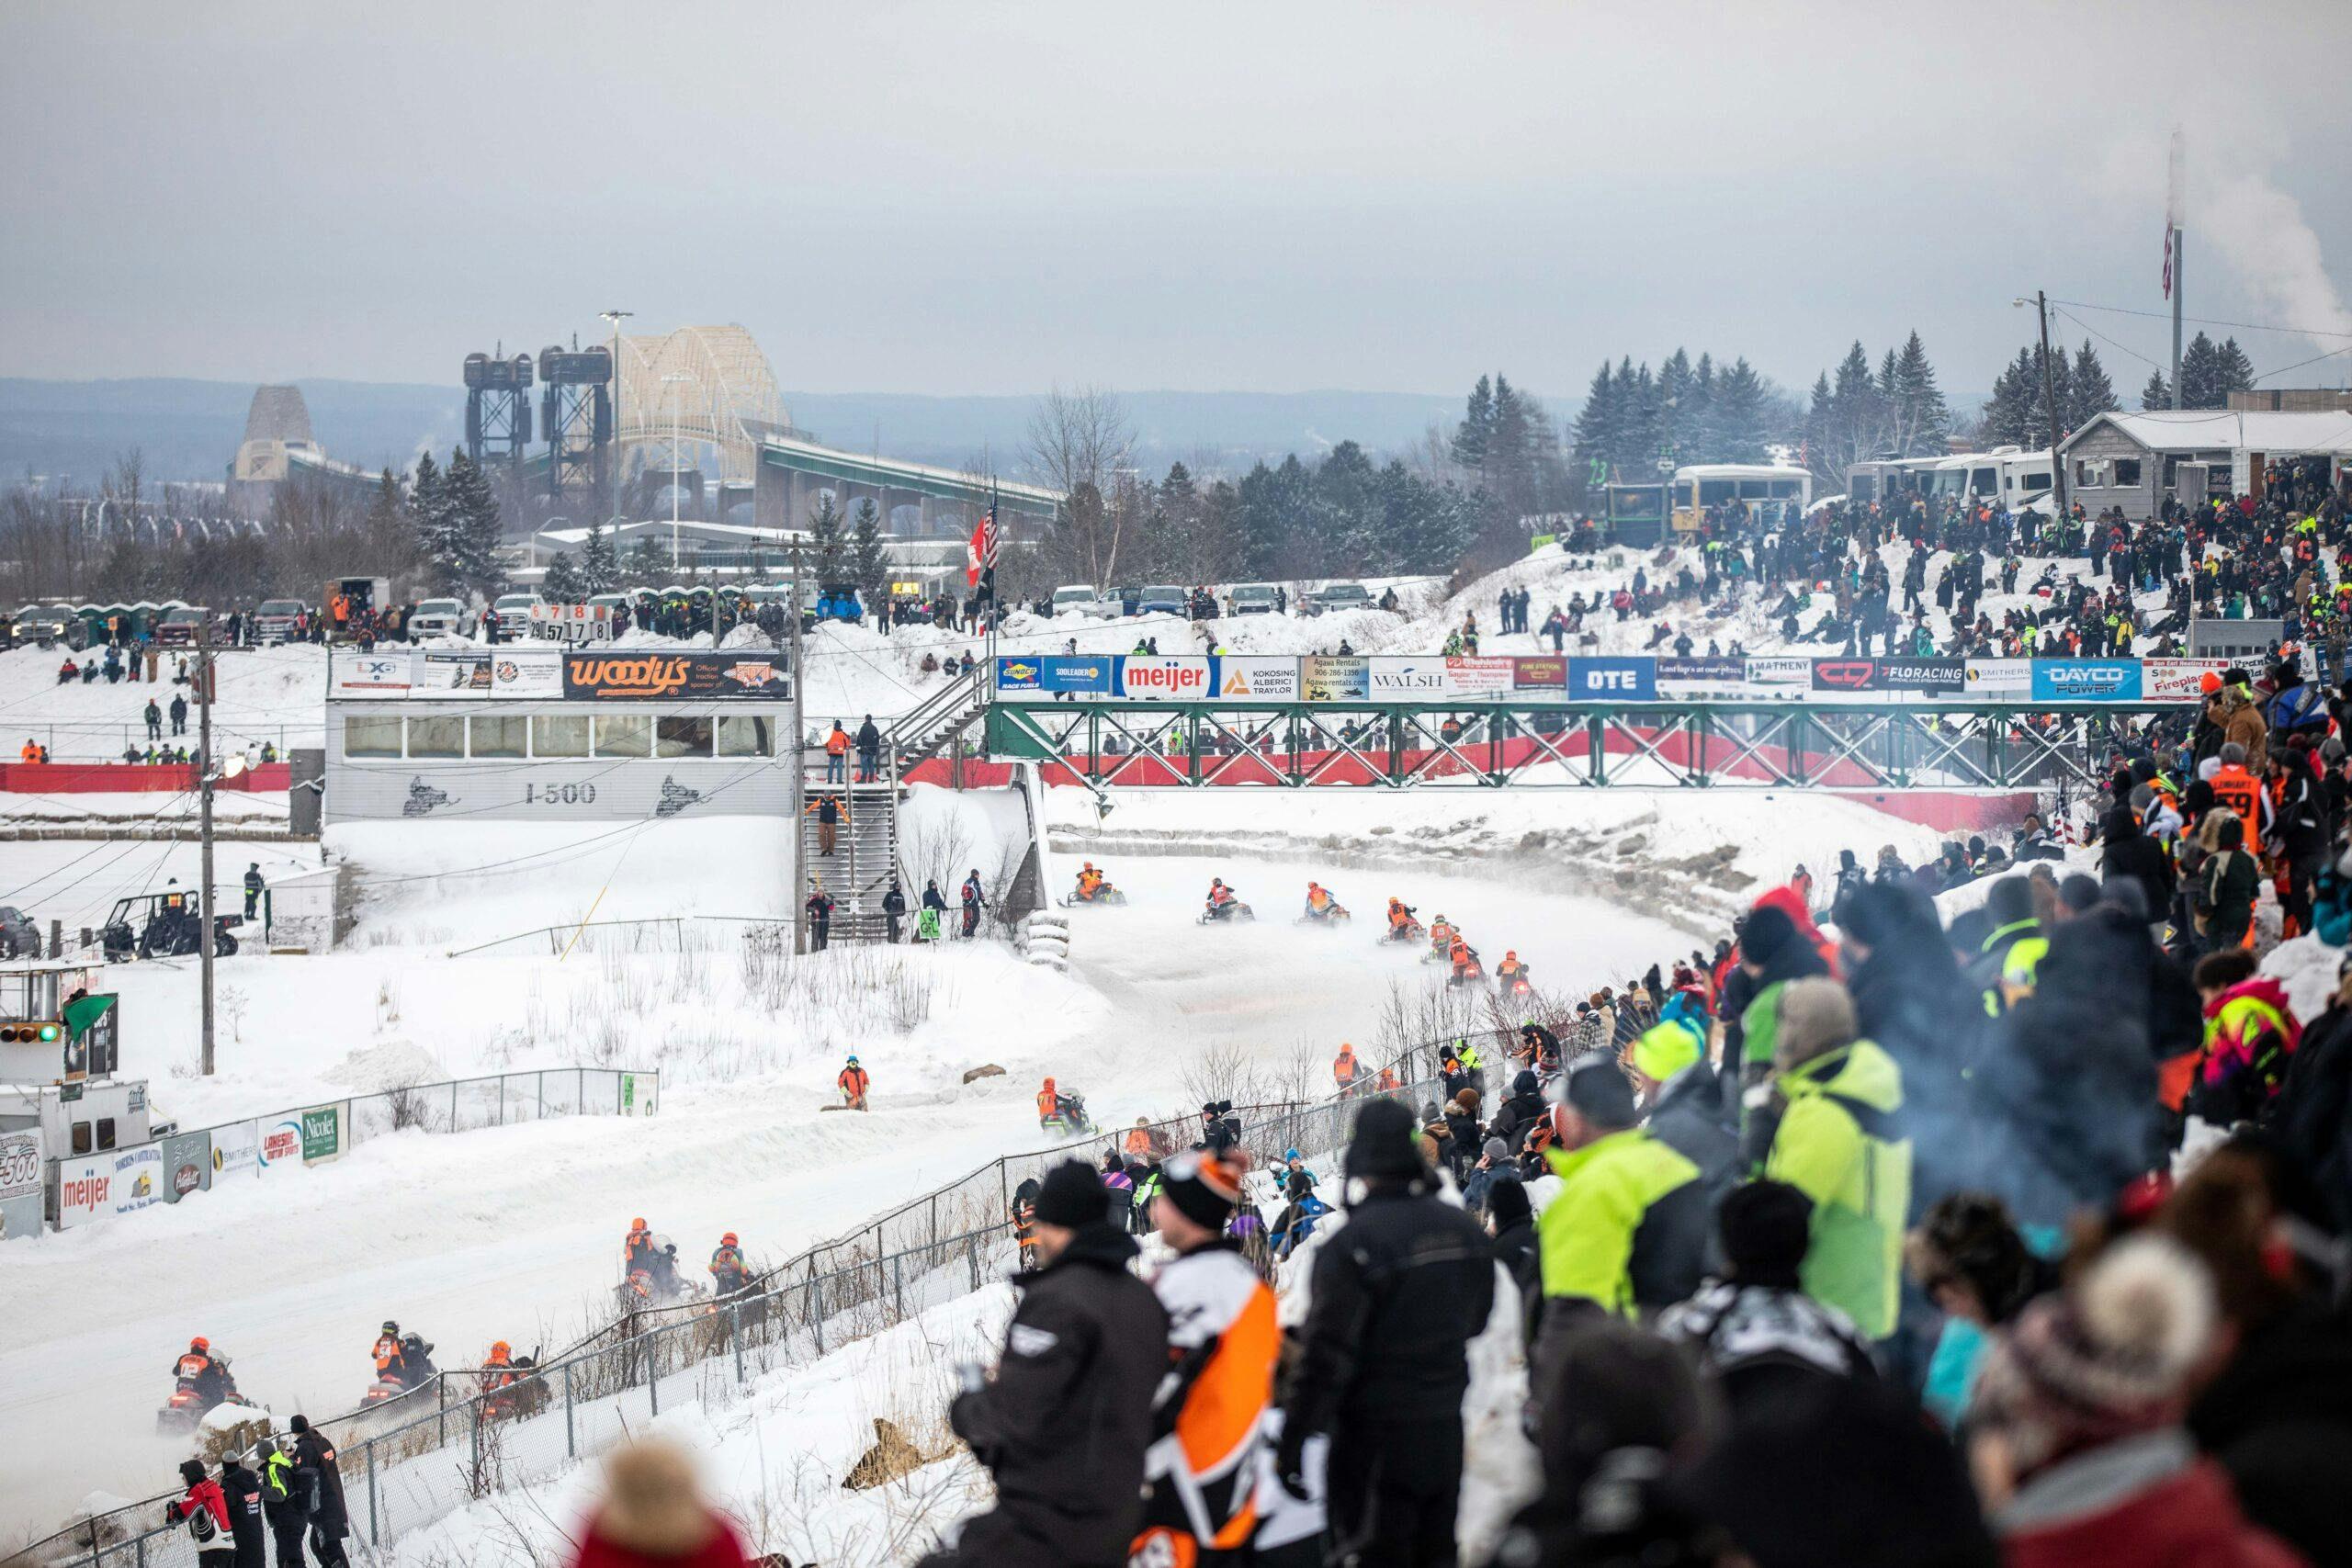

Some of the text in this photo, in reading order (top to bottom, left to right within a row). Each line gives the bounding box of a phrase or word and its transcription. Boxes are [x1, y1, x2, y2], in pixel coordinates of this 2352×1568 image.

[532, 605, 605, 619] 6 7 8 9
[531, 622, 604, 641] 29 57 7 8
[1314, 659, 1361, 668] Agawa Rentals
[1696, 665, 1704, 673] at
[1756, 661, 1808, 670] MATHENY
[1004, 668, 1036, 676] SUNOCO
[1056, 668, 1090, 677] SOOLEADER
[1128, 661, 1204, 692] meijer
[1252, 670, 1296, 678] KOKOSING
[1889, 667, 1962, 680] FLORACING
[2049, 667, 2124, 682] DAYCO
[1306, 678, 1368, 686] Agawa-rentals.com
[1374, 675, 1442, 687] WALSH
[1587, 670, 1637, 691] DTE
[2056, 683, 2117, 694] POWER
[526, 783, 596, 806] I-500
[305, 1114, 334, 1140] Nicolet
[264, 1131, 295, 1151] LAKESIDE
[224, 1145, 257, 1163] SMITHERS
[64, 1169, 110, 1213] meijer
[180, 1363, 199, 1380] 02
